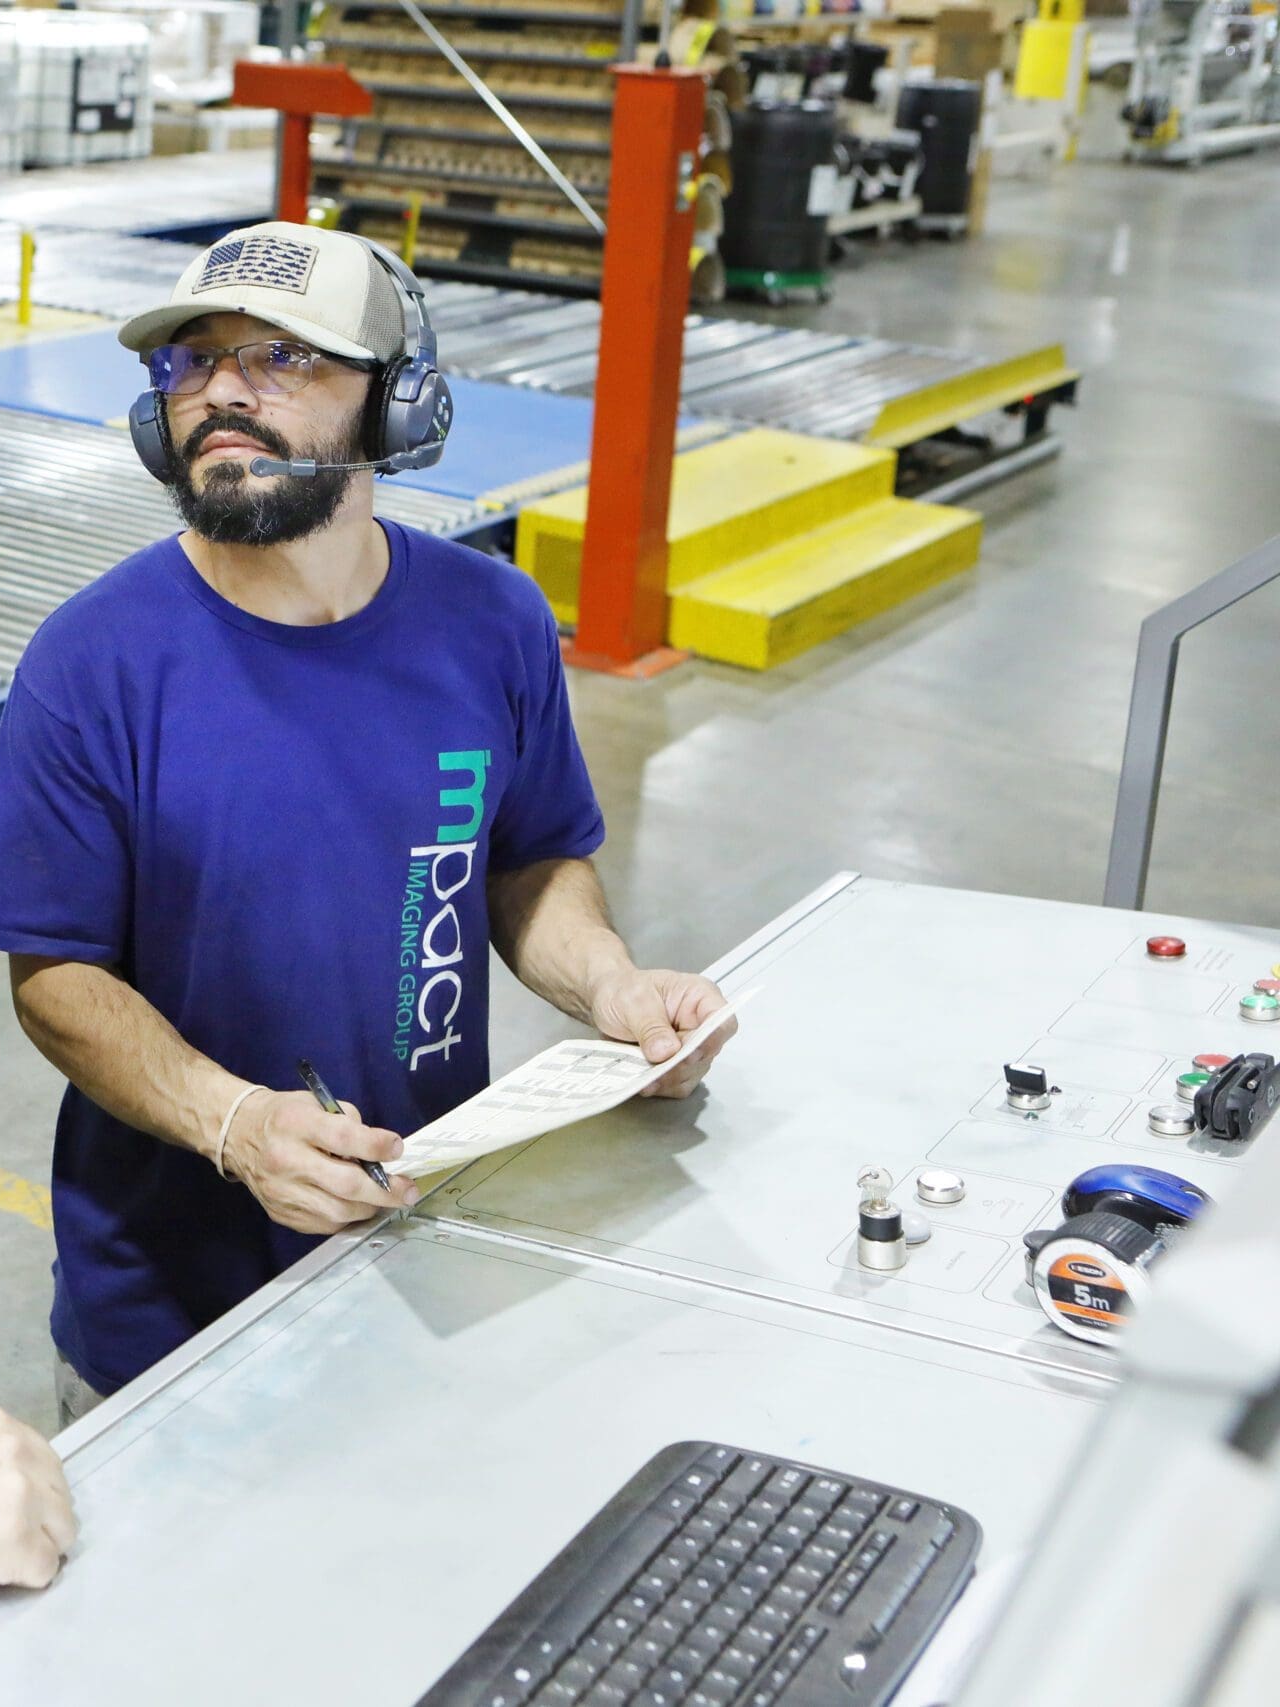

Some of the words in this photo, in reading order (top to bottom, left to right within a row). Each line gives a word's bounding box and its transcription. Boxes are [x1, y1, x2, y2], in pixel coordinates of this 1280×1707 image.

[400, 861, 429, 968] IMAGING
[393, 973, 416, 1060] GROUP
[1075, 1284, 1111, 1311] 5m
